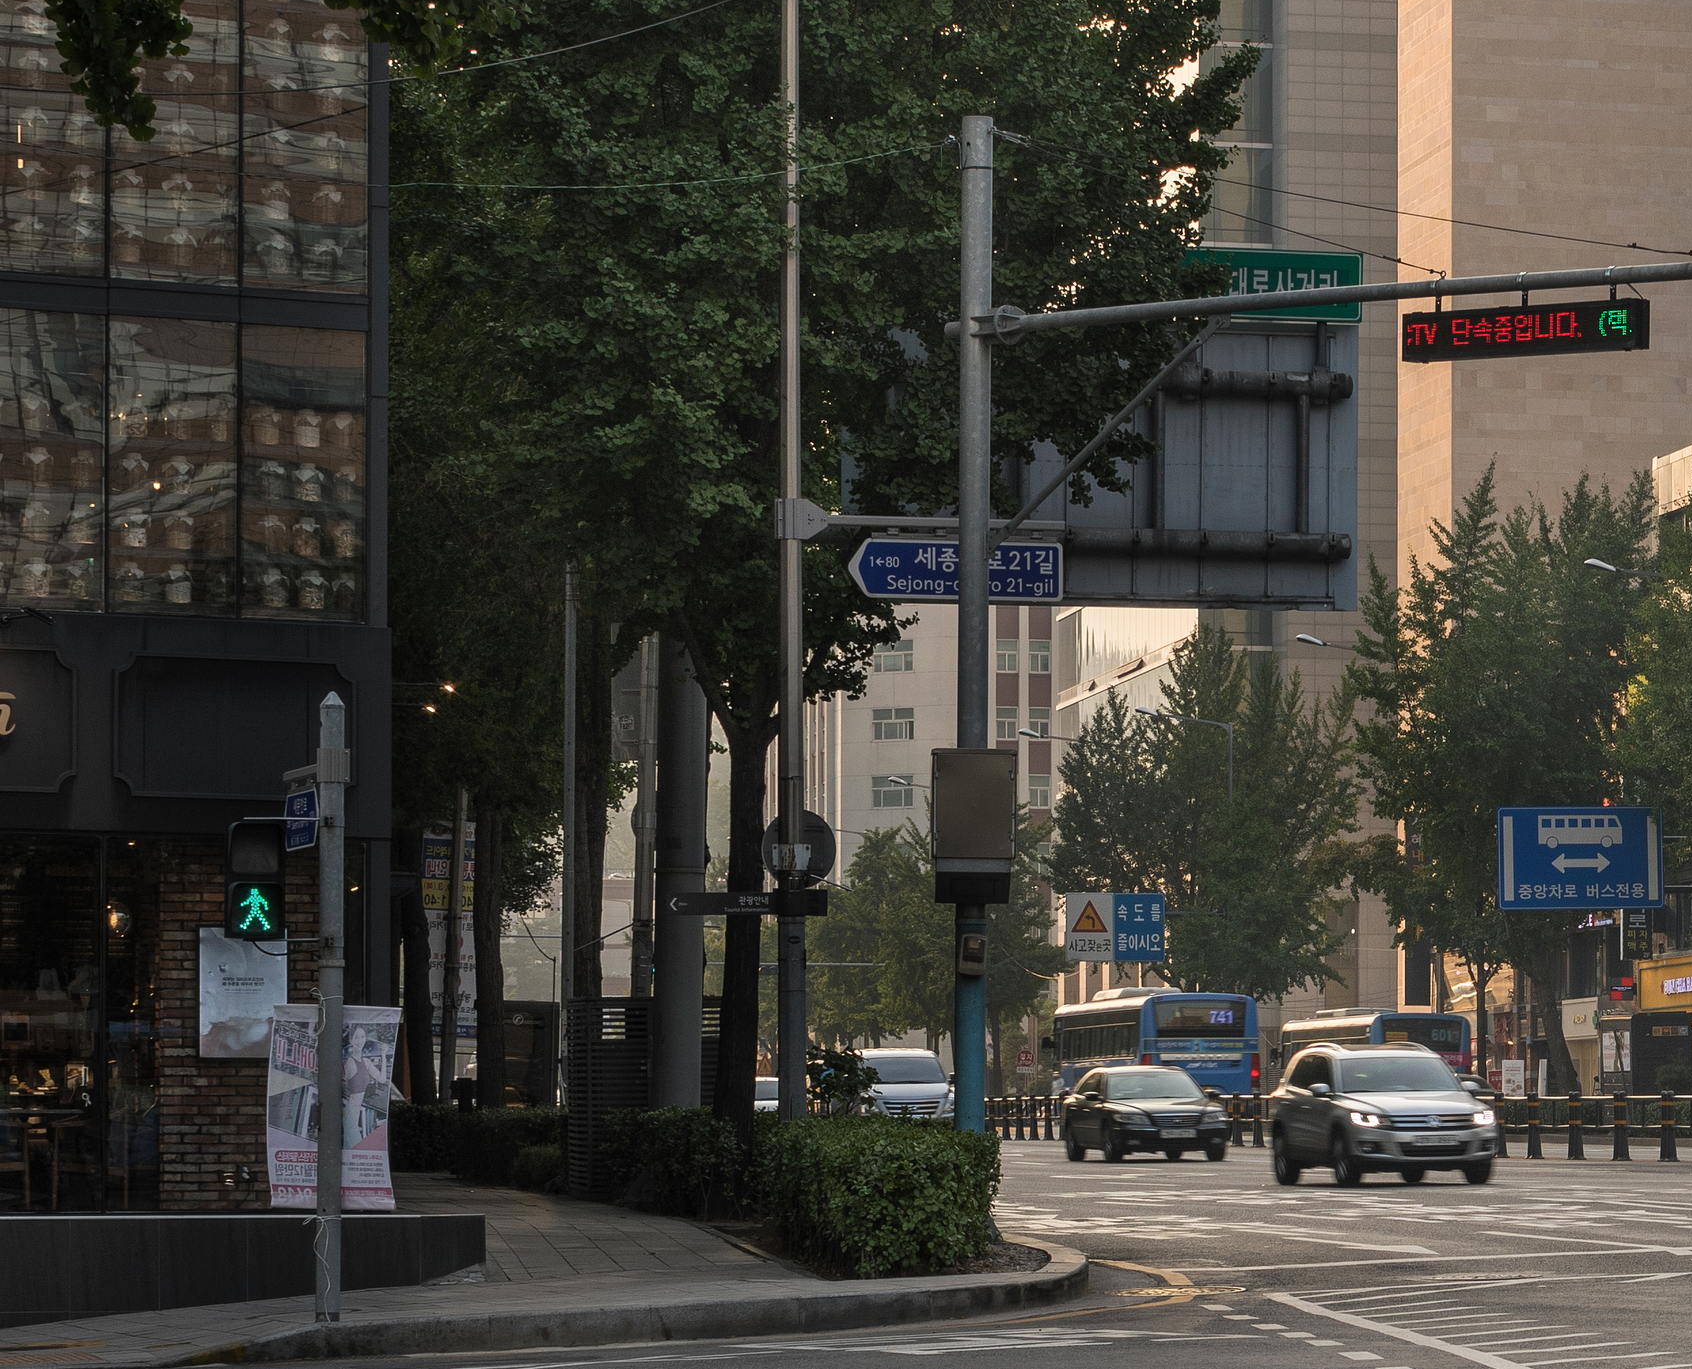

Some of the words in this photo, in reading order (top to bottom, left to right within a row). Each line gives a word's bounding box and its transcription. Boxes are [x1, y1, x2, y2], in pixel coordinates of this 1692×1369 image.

[1451, 311, 1582, 346] 단속중입니다.
[914, 547, 1053, 575] 세종로21길
[1518, 884, 1578, 899] 중앙차로
[1586, 883, 1646, 899] 버스전용
[738, 896, 769, 905] 관광안내
[1117, 903, 1161, 922] 속도를
[1627, 929, 1648, 940] 피자
[1068, 939, 1112, 952] 사고잦은곳
[1117, 933, 1161, 951] 줄이시오
[1627, 941, 1649, 951] 맥주
[1209, 1010, 1233, 1023] 741
[1431, 1028, 1451, 1041] 601
